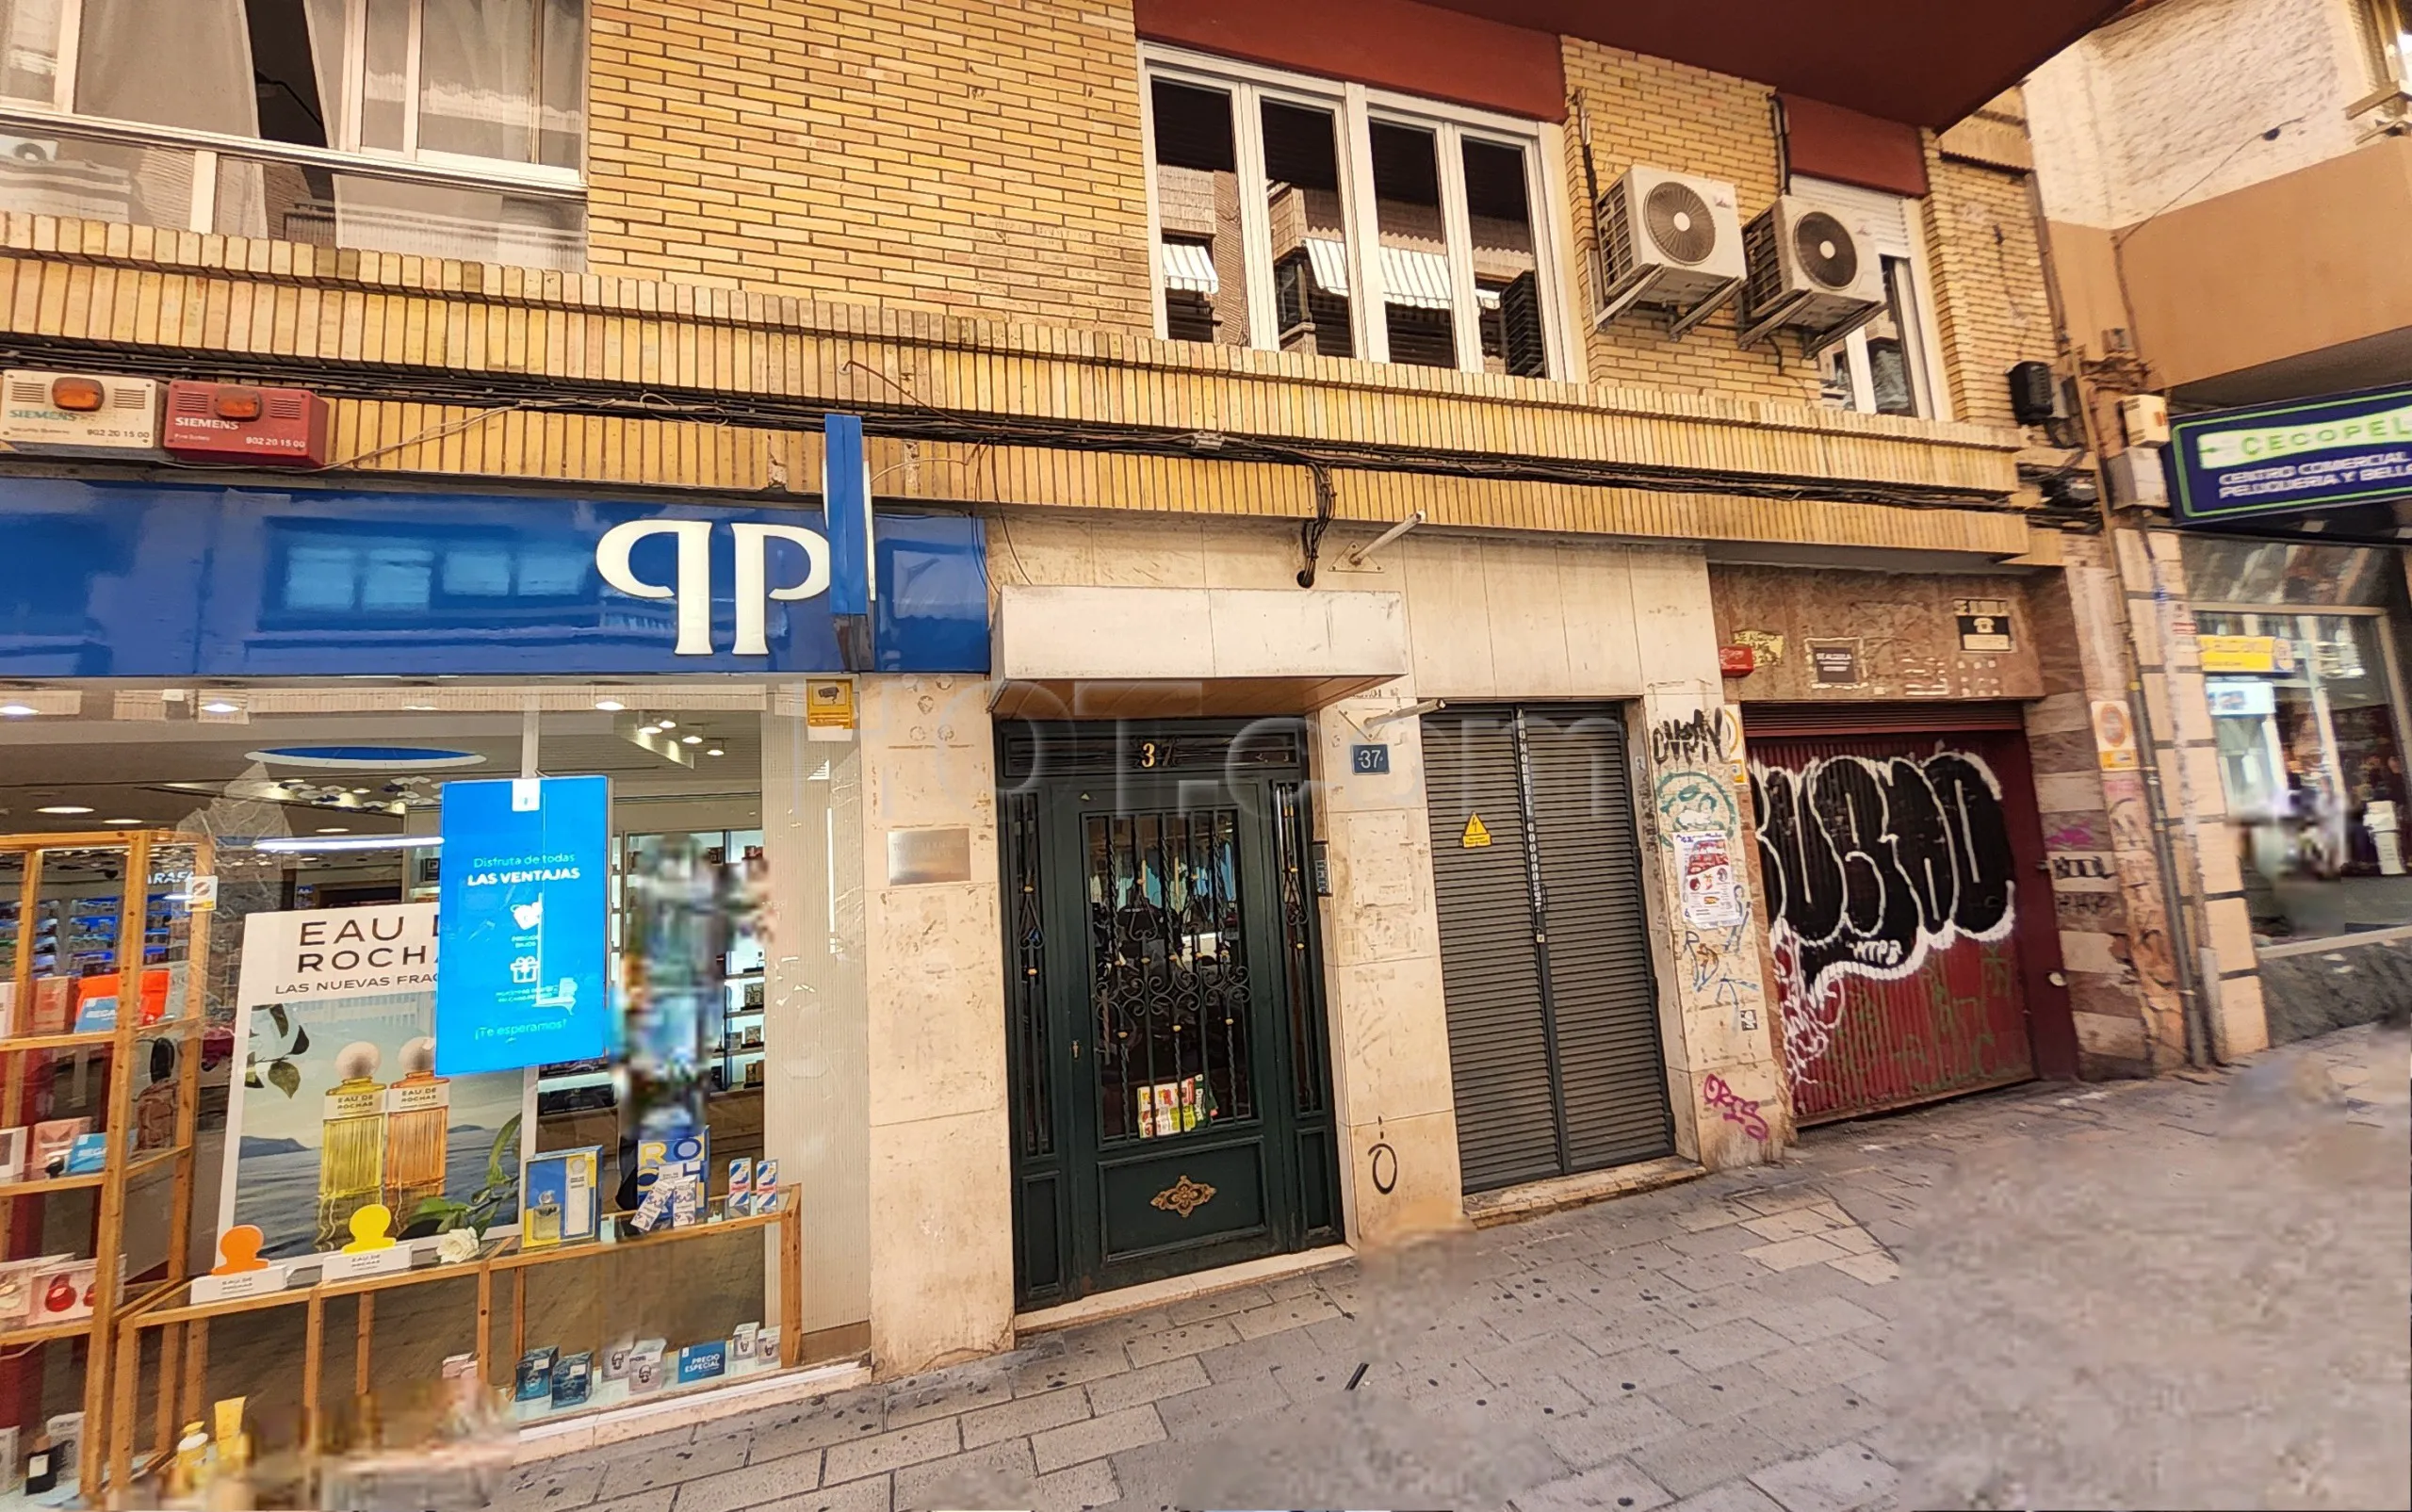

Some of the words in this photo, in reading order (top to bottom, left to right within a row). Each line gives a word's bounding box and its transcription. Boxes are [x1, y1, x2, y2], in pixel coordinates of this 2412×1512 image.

[9, 409, 77, 422] SIEMENS
[174, 416, 239, 431] SIEMENS
[245, 436, 264, 447] 902
[265, 437, 278, 447] 20
[280, 438, 292, 447] 15
[292, 440, 306, 448] 00
[2219, 465, 2296, 485] CENTRO
[2298, 451, 2410, 476] COMERCIAL
[2359, 463, 2412, 482] BELL
[473, 856, 522, 869] Disfruta
[524, 854, 540, 865] de
[542, 853, 576, 864] todas
[467, 872, 498, 886] LAS
[499, 867, 581, 885] VENTAJAS
[300, 916, 404, 946] EAU
[275, 983, 309, 995] LAS
[316, 976, 391, 991] NUEVAS
[336, 1101, 374, 1110] ROCHAS
[400, 1095, 437, 1103] ROCHAS
[692, 1353, 721, 1364] PRECIO
[684, 1360, 721, 1374] ESPECIAL
